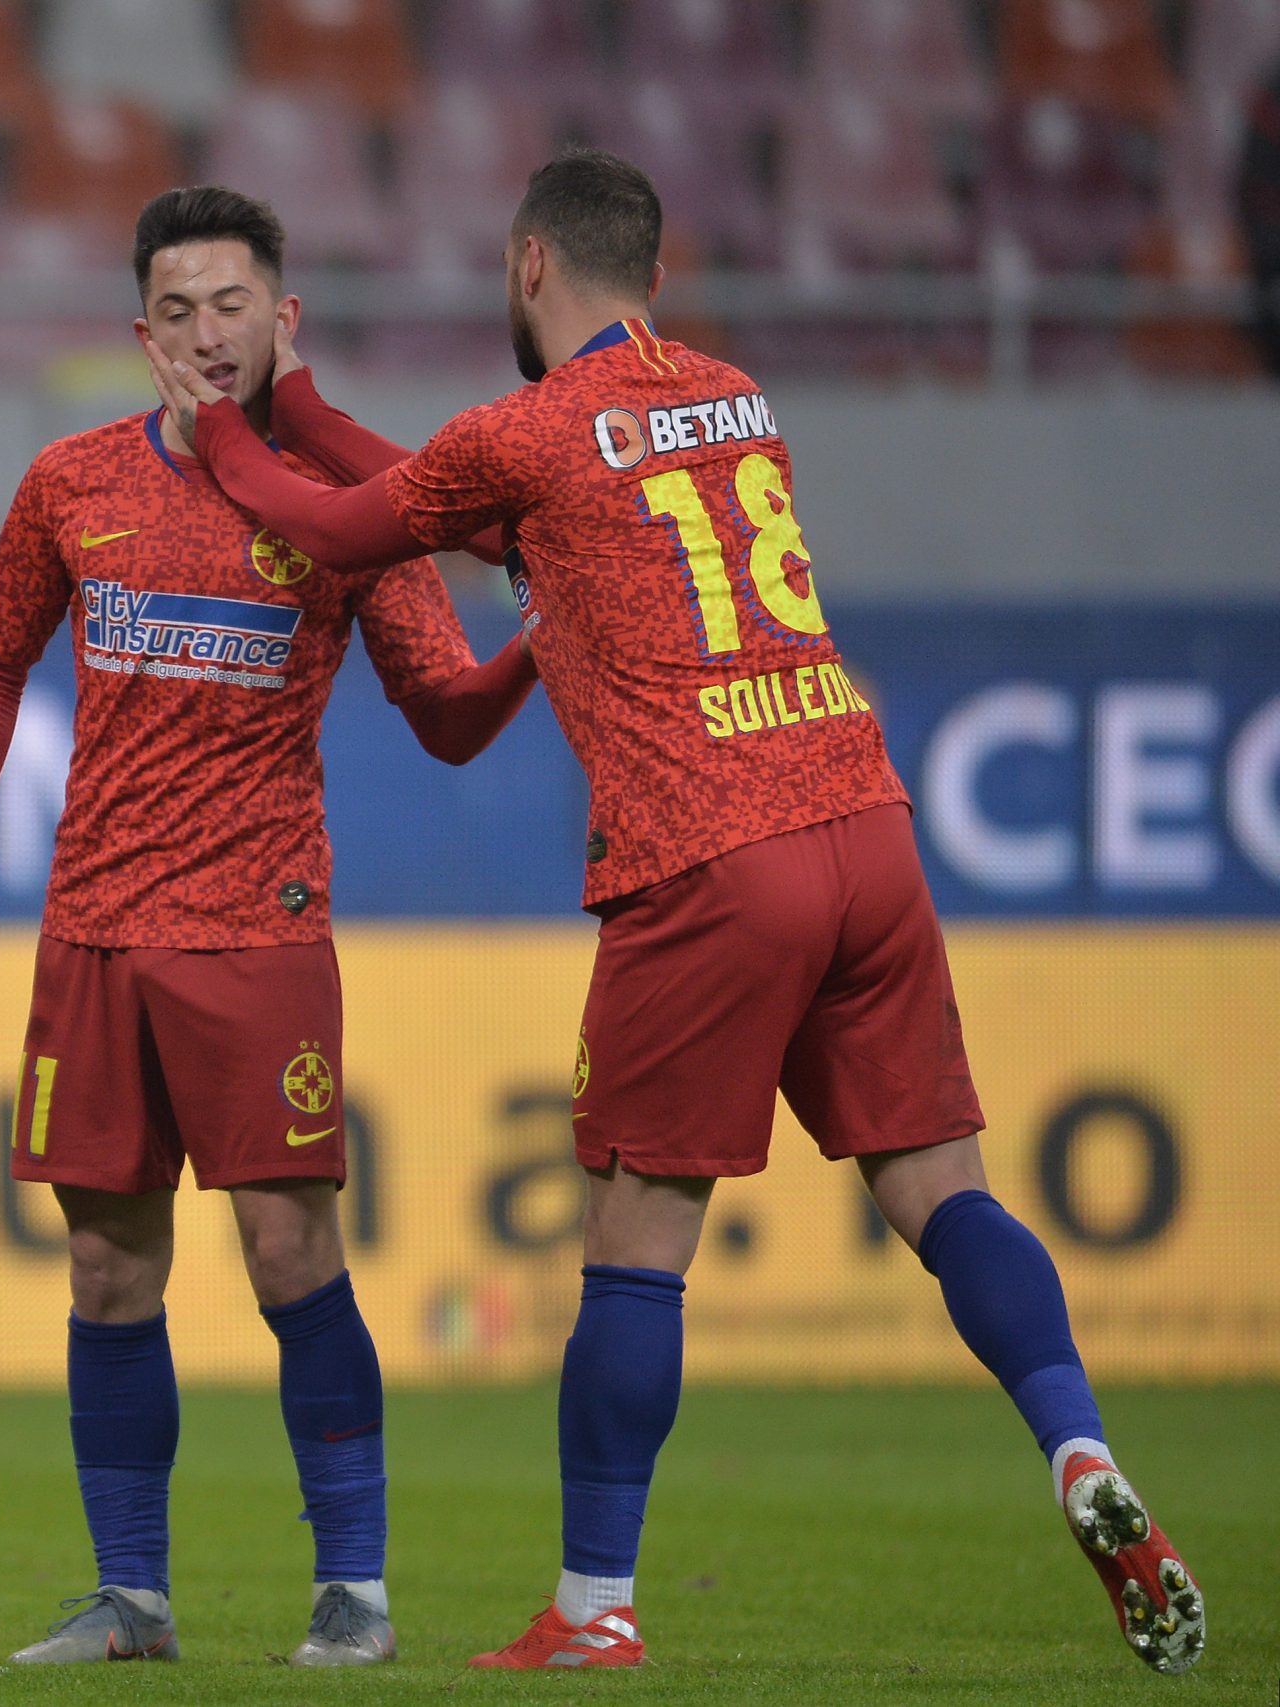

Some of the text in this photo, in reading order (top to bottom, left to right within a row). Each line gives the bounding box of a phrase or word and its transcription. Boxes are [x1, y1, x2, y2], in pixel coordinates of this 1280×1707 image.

[641, 453, 827, 653] 18
[80, 578, 149, 625] City
[98, 615, 291, 667] Insurance
